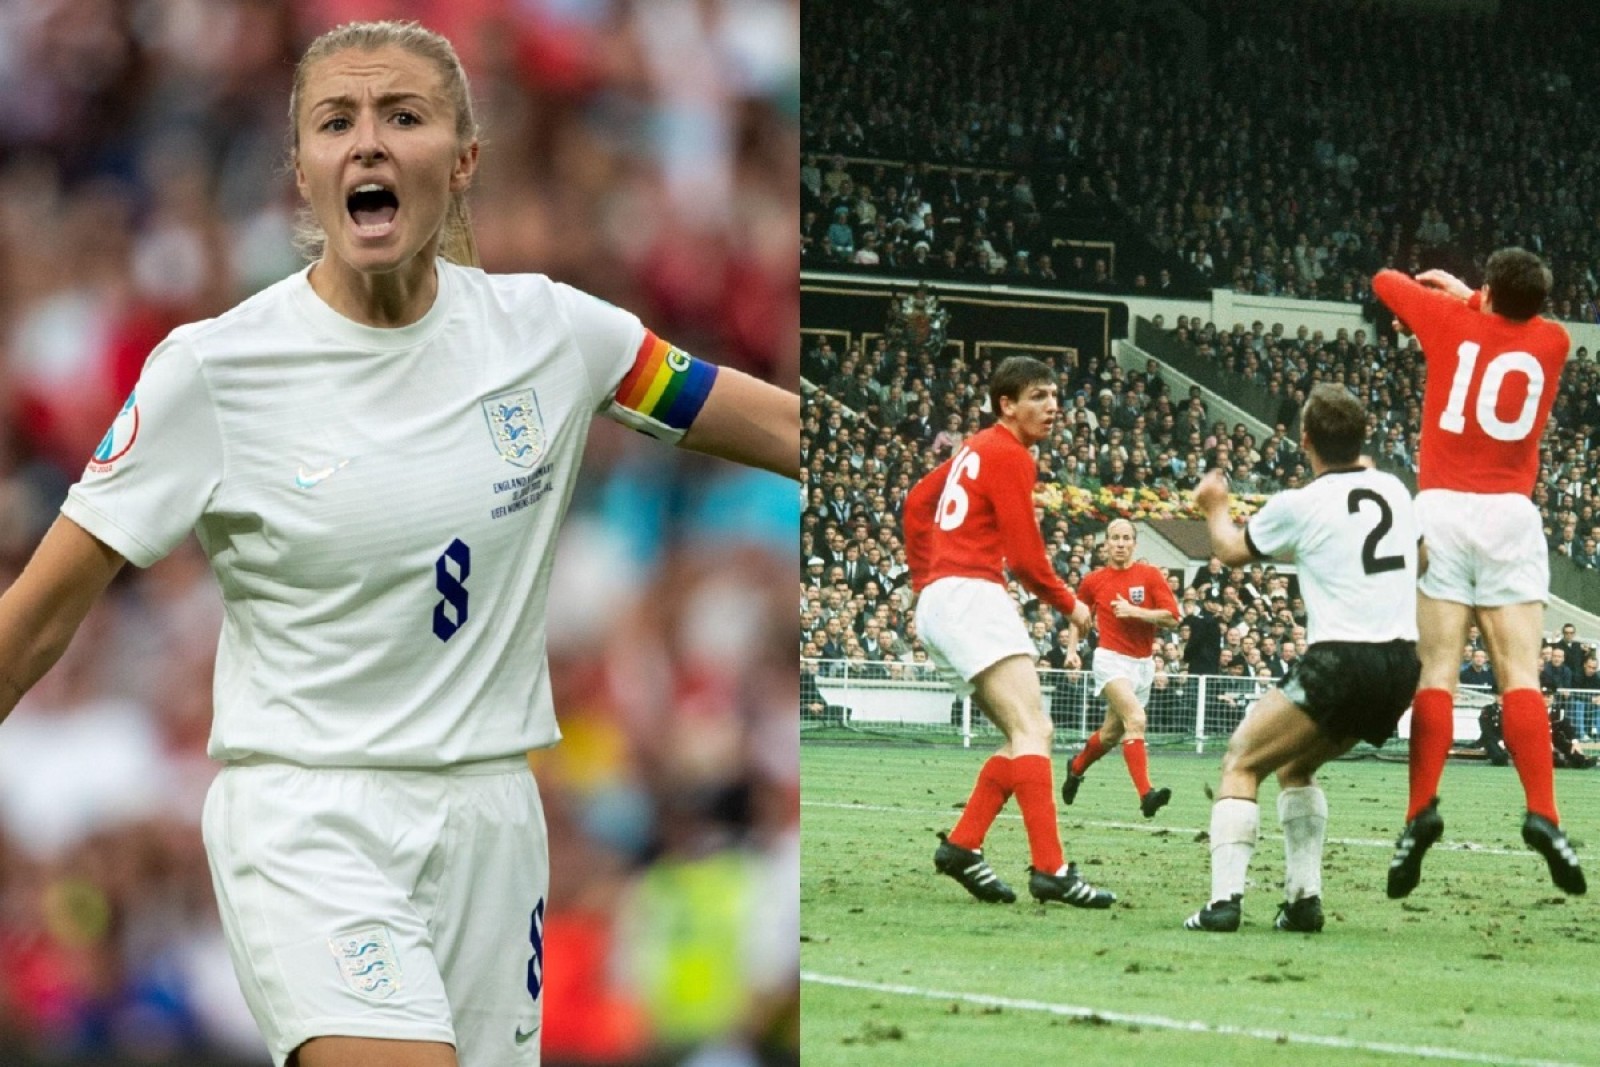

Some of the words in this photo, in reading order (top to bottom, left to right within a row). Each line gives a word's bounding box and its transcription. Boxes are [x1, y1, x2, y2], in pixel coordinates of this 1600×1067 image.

[1439, 340, 1545, 441] 10
[492, 476, 527, 494] ENGLAND
[934, 446, 980, 531] 16
[1347, 488, 1405, 575] 2
[433, 537, 470, 643] 8
[527, 896, 544, 1001] 8
